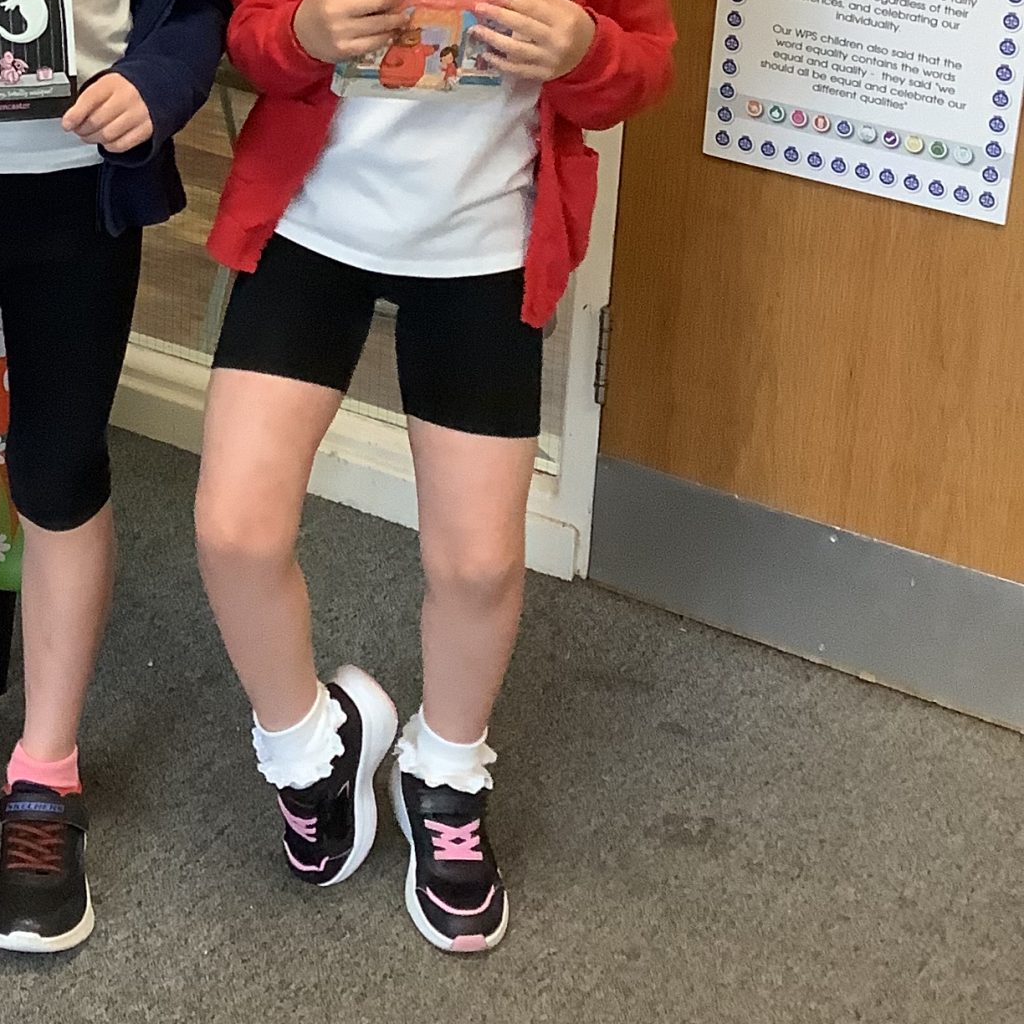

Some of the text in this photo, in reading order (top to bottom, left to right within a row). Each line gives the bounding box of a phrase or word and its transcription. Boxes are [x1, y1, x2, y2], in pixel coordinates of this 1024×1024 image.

[772, 23, 963, 71] Our WPS children also said that the
[812, 82, 857, 100] different
